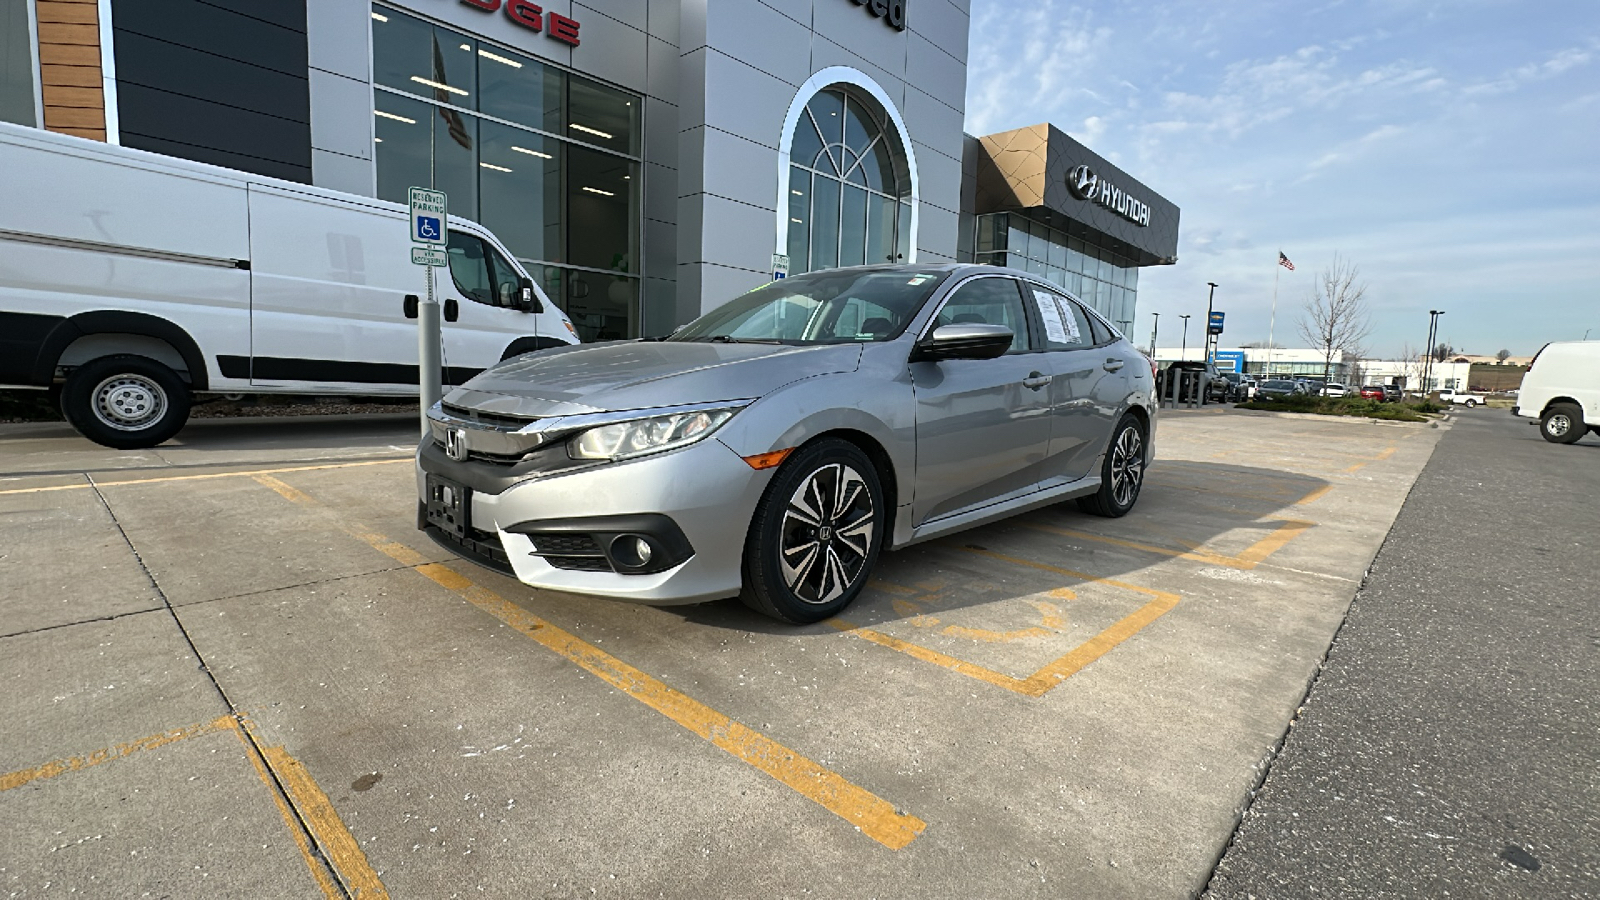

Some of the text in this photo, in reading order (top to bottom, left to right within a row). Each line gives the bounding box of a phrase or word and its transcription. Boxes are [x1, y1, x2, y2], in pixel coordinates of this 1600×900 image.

[413, 192, 443, 204] RESERVED
[1101, 179, 1151, 227] HYUNDAI
[413, 202, 443, 213] PARKING
